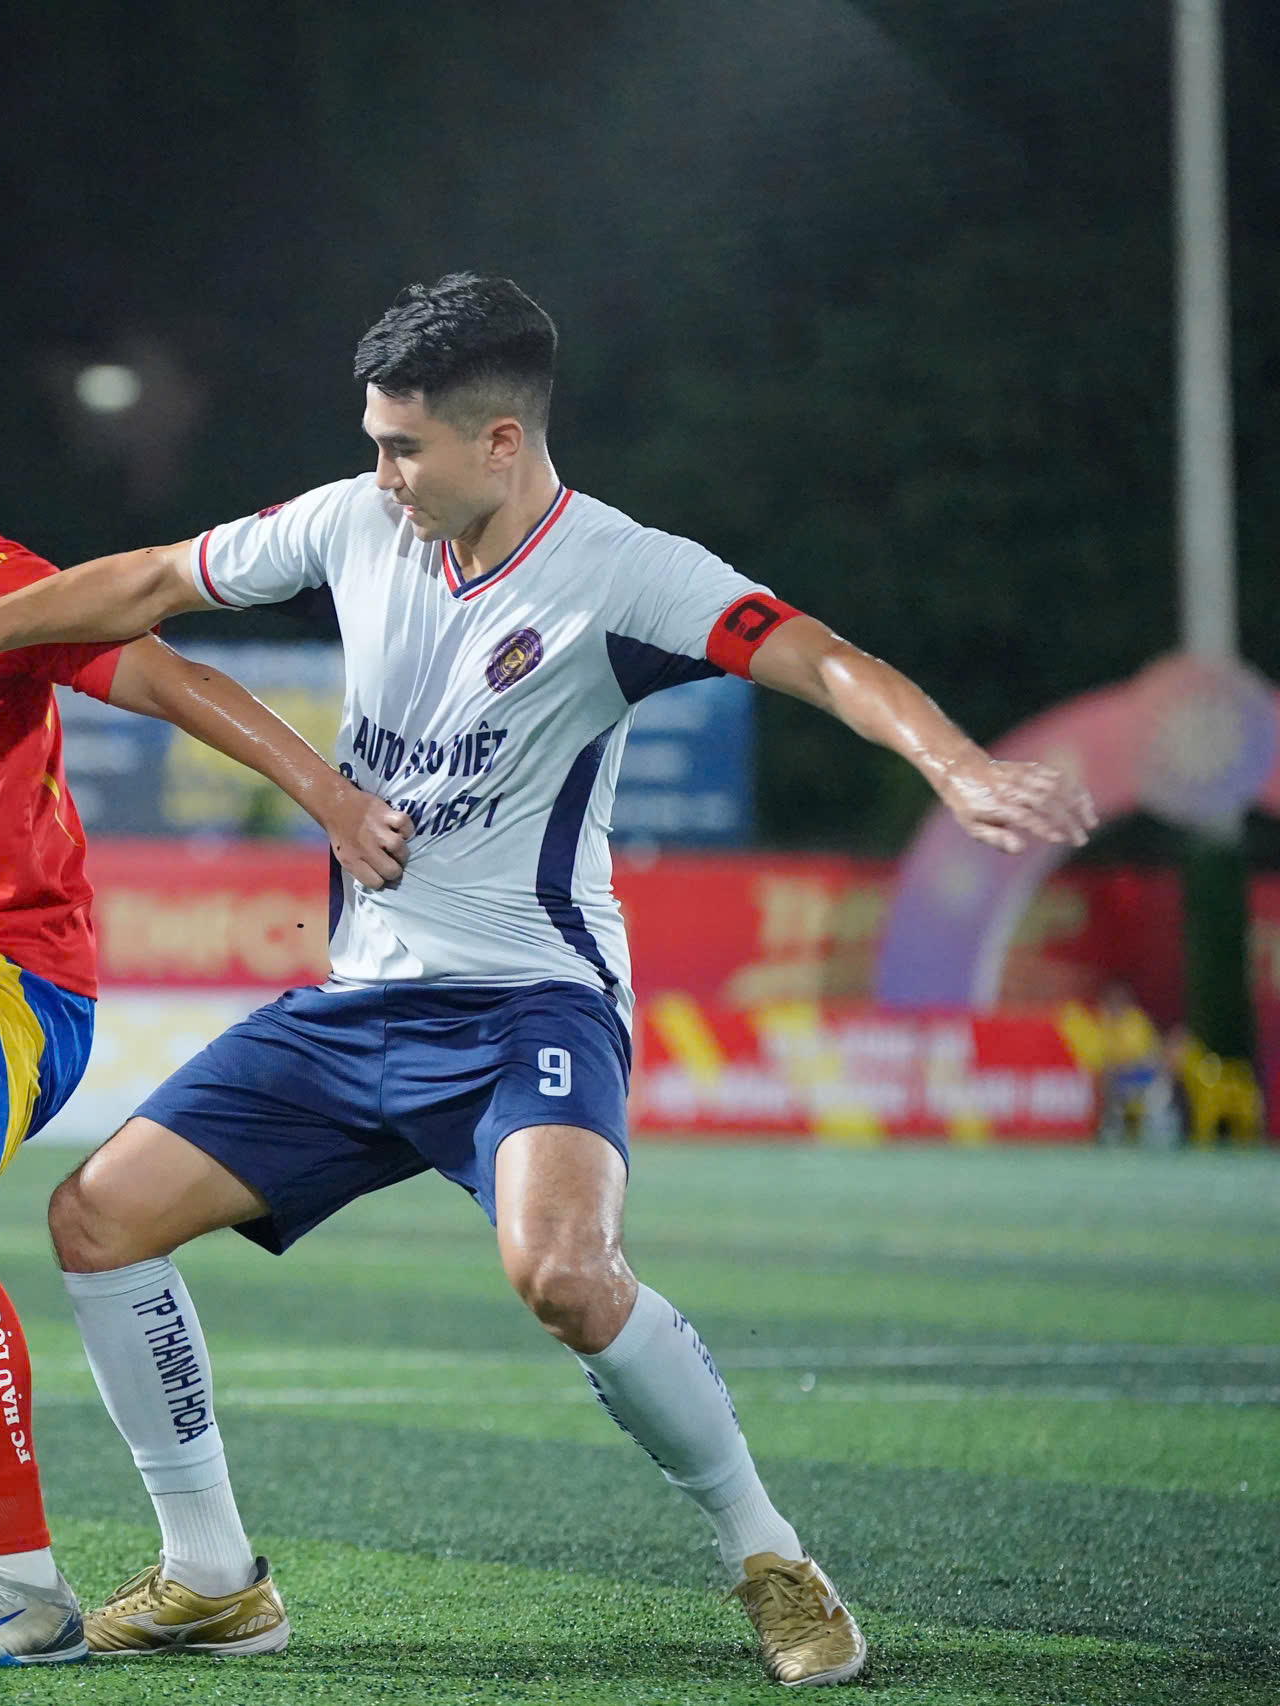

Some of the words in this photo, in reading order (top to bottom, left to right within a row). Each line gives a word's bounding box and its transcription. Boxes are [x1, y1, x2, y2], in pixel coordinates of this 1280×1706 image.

[353, 715, 405, 781] AUTO
[537, 1047, 572, 1097] 9
[132, 1288, 178, 1316] TP
[144, 1314, 203, 1394] THANH
[10, 1430, 32, 1464] FC
